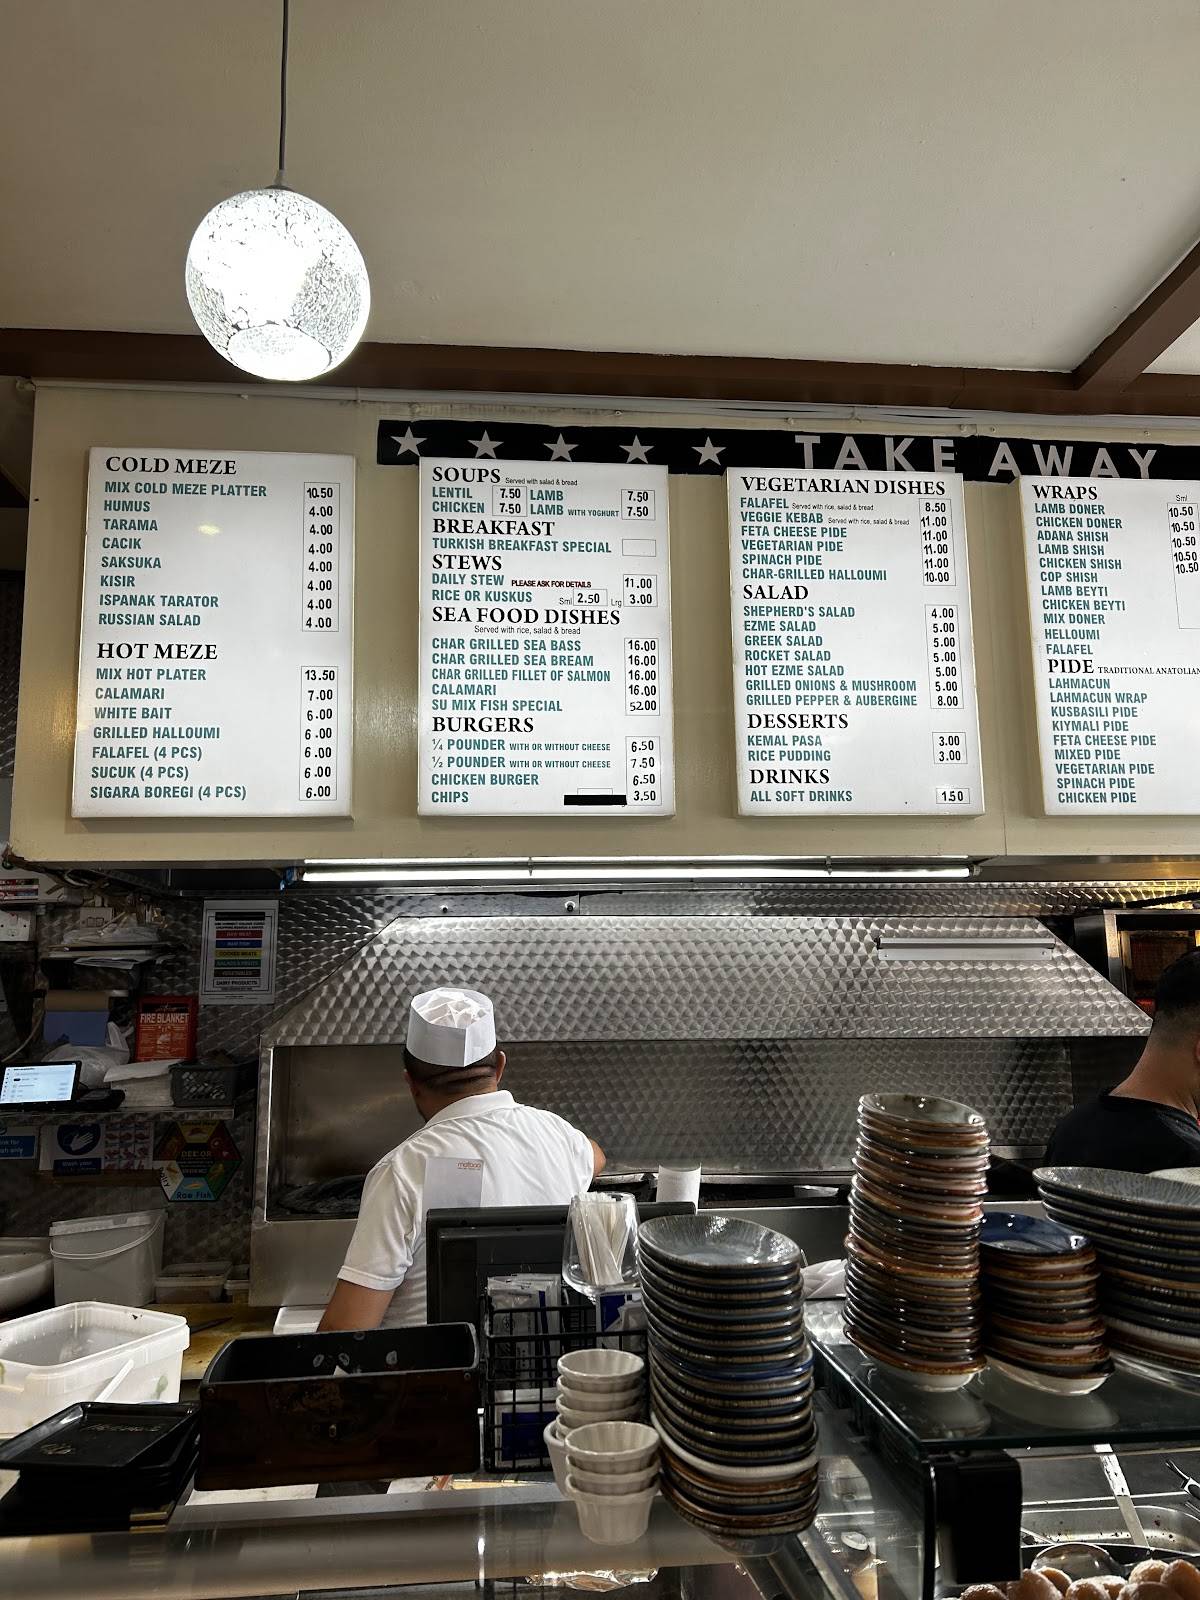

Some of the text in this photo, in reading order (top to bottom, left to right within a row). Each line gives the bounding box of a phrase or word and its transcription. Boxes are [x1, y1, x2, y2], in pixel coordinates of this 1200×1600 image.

[794, 434, 1157, 479] TAKE AWAY
[106, 456, 236, 476] COLD MEZE
[432, 466, 500, 483] SOUPS
[105, 481, 333, 500] MIX COLD MEZE PLATTER 10.50
[740, 476, 945, 496] VEGETARIAN DISHES
[1032, 485, 1097, 502] WRAPS
[432, 486, 649, 503] LENTIL 7.50 LAMB 7.50
[104, 500, 333, 518] HUMUS 4.00
[432, 501, 484, 513] CHICKEN
[499, 502, 521, 514] 7.50
[530, 504, 564, 515] LAMB
[627, 506, 648, 517] 7.50
[1035, 503, 1193, 520] LAMB DONER 10.50
[104, 518, 332, 536] TARAMA 4.00
[432, 518, 555, 536] BREAKFAST
[1036, 516, 1194, 533] CHICKEN DONER 10.50
[741, 525, 947, 542] FETA CHEESE PIDE 11.00
[1037, 530, 1196, 548] ADANA SHISH 10.50
[102, 537, 332, 555] CACIK 4.00
[432, 538, 612, 553] TURKISH BREAKFAST SPECIAL
[742, 539, 948, 555] VEGETARIAN PIDE 11.00
[101, 556, 332, 572] SAKSUKA 4.00
[432, 554, 502, 570] STEWS
[432, 573, 466, 584] DAILY
[471, 574, 504, 586] STEW
[551, 580, 564, 588] FOR
[566, 580, 591, 588] DETAILS
[625, 578, 652, 588] 11.00
[743, 568, 949, 582] CHAR-GRILLED HALLOUMI 10.00
[100, 575, 332, 591] KISIR 4.00
[743, 584, 808, 600] SALAD
[100, 594, 332, 610] ISPANAK TARATOR 4.00
[1042, 599, 1125, 611] CHICKEN BEYTI
[432, 606, 620, 625] SEA FOOD DISHES
[744, 606, 954, 618] SHEPHERD'S SALAD 4.00
[99, 613, 332, 628] RUSSIAN SALAD 4.00
[744, 620, 954, 633] EZME SALAD 5.00
[745, 635, 955, 648] GREEK SALAD 5.00
[1044, 629, 1100, 640] HELLOUMI
[96, 643, 218, 660] HOT MEZE
[432, 638, 656, 652] CHAR GRILLED SEA BASS 16.00
[745, 650, 956, 662] ROCKET SALAD 5.00
[1047, 659, 1094, 673] PIDE
[96, 668, 335, 681] MIX HOT PLATER 13.50
[432, 684, 656, 696] CALAMARI 16.00
[1049, 678, 1110, 689] LAHMACUN
[96, 688, 333, 701] CALAMARI 7.00
[1050, 692, 1147, 703] LAHMACUN WRAP
[94, 707, 332, 721] WHITE BAIT 6.00
[1051, 706, 1138, 717] KUSBASILI PIDE
[432, 717, 533, 732] BURGERS
[747, 714, 848, 728] DESSERTS
[1052, 721, 1128, 731] KIYMALI PIDE
[94, 727, 332, 740] GRILLED HALLOUMI 6.00
[748, 735, 960, 746] KEMAL PASA 3.00
[748, 750, 960, 762] RICE PUDDING 3.00
[1054, 749, 1120, 760] MIXED PIDE
[432, 774, 655, 786] CHICKEN BURGER 6.50
[749, 769, 829, 784] DRINKS
[1057, 778, 1135, 788] SPINACH PIDE
[432, 790, 656, 802] CHIPS 3.50
[140, 1013, 189, 1024] FIRE BLANKET
